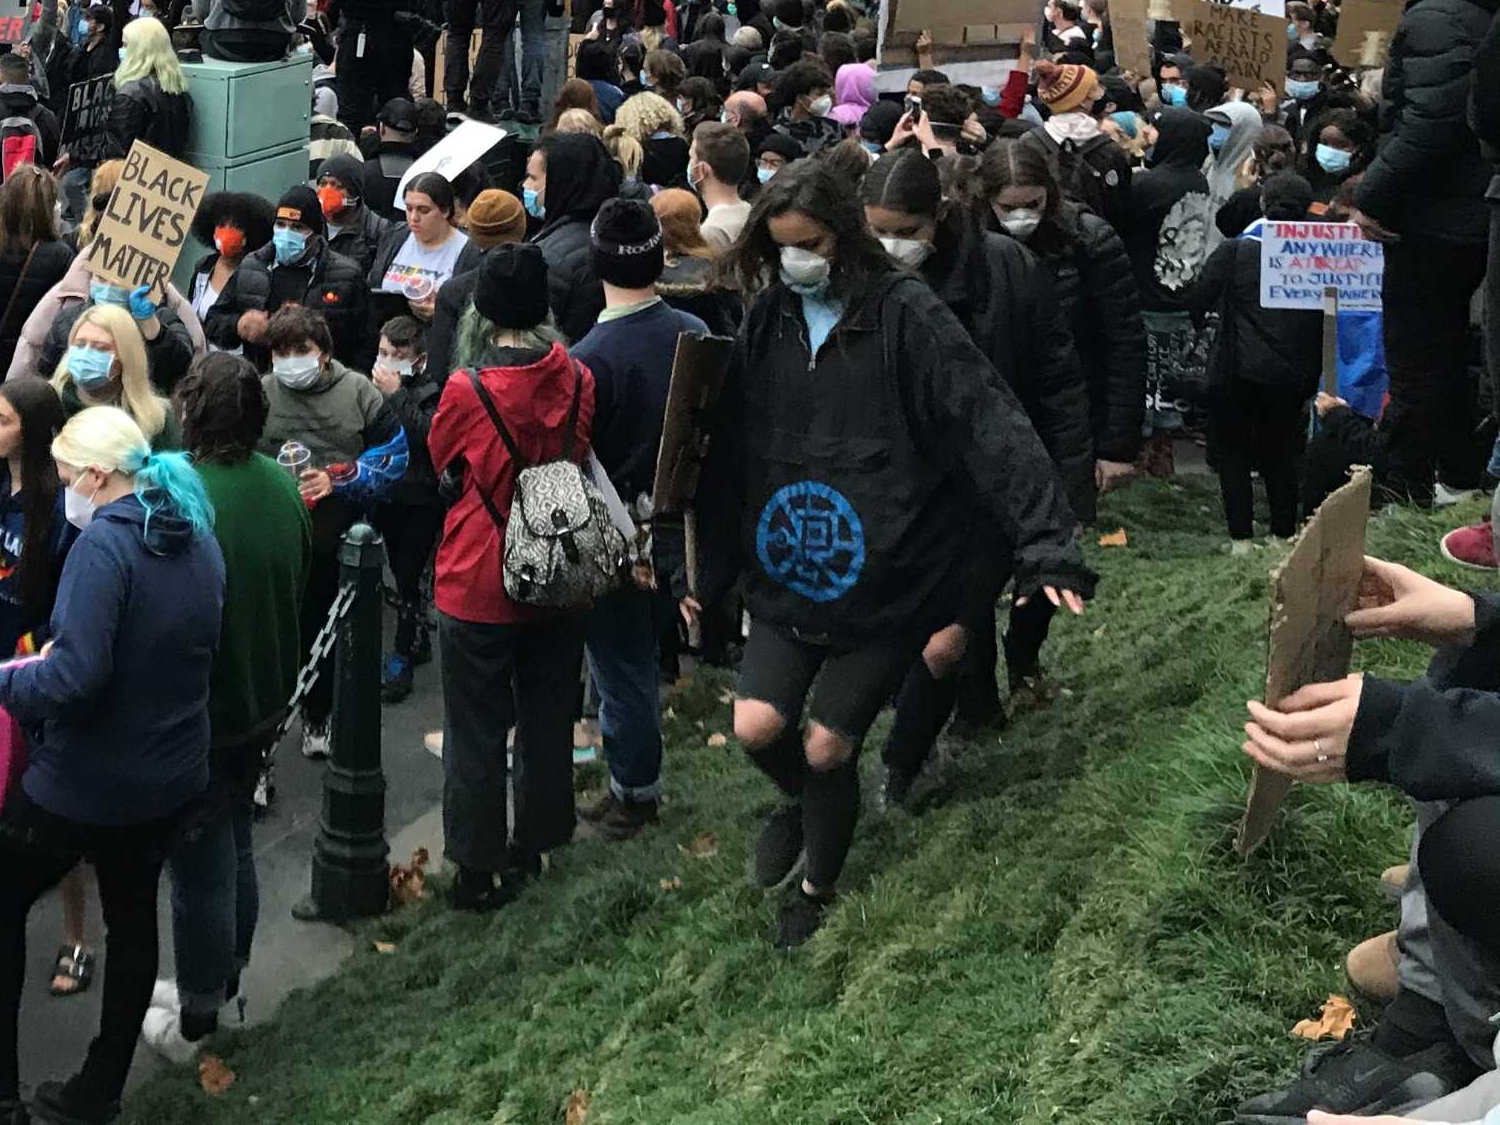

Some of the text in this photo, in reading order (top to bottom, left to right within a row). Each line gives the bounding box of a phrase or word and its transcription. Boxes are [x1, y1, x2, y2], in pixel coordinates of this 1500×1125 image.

[1210, 5, 1261, 28] MAKE
[1194, 20, 1274, 52] RACISTS
[1204, 38, 1270, 64] AFRAID
[72, 81, 116, 112] BLAC
[121, 150, 203, 209] BLACK
[106, 186, 185, 247] LIVES
[88, 232, 170, 295] MATTER
[1269, 257, 1283, 269] IS
[1281, 273, 1302, 285] TO
